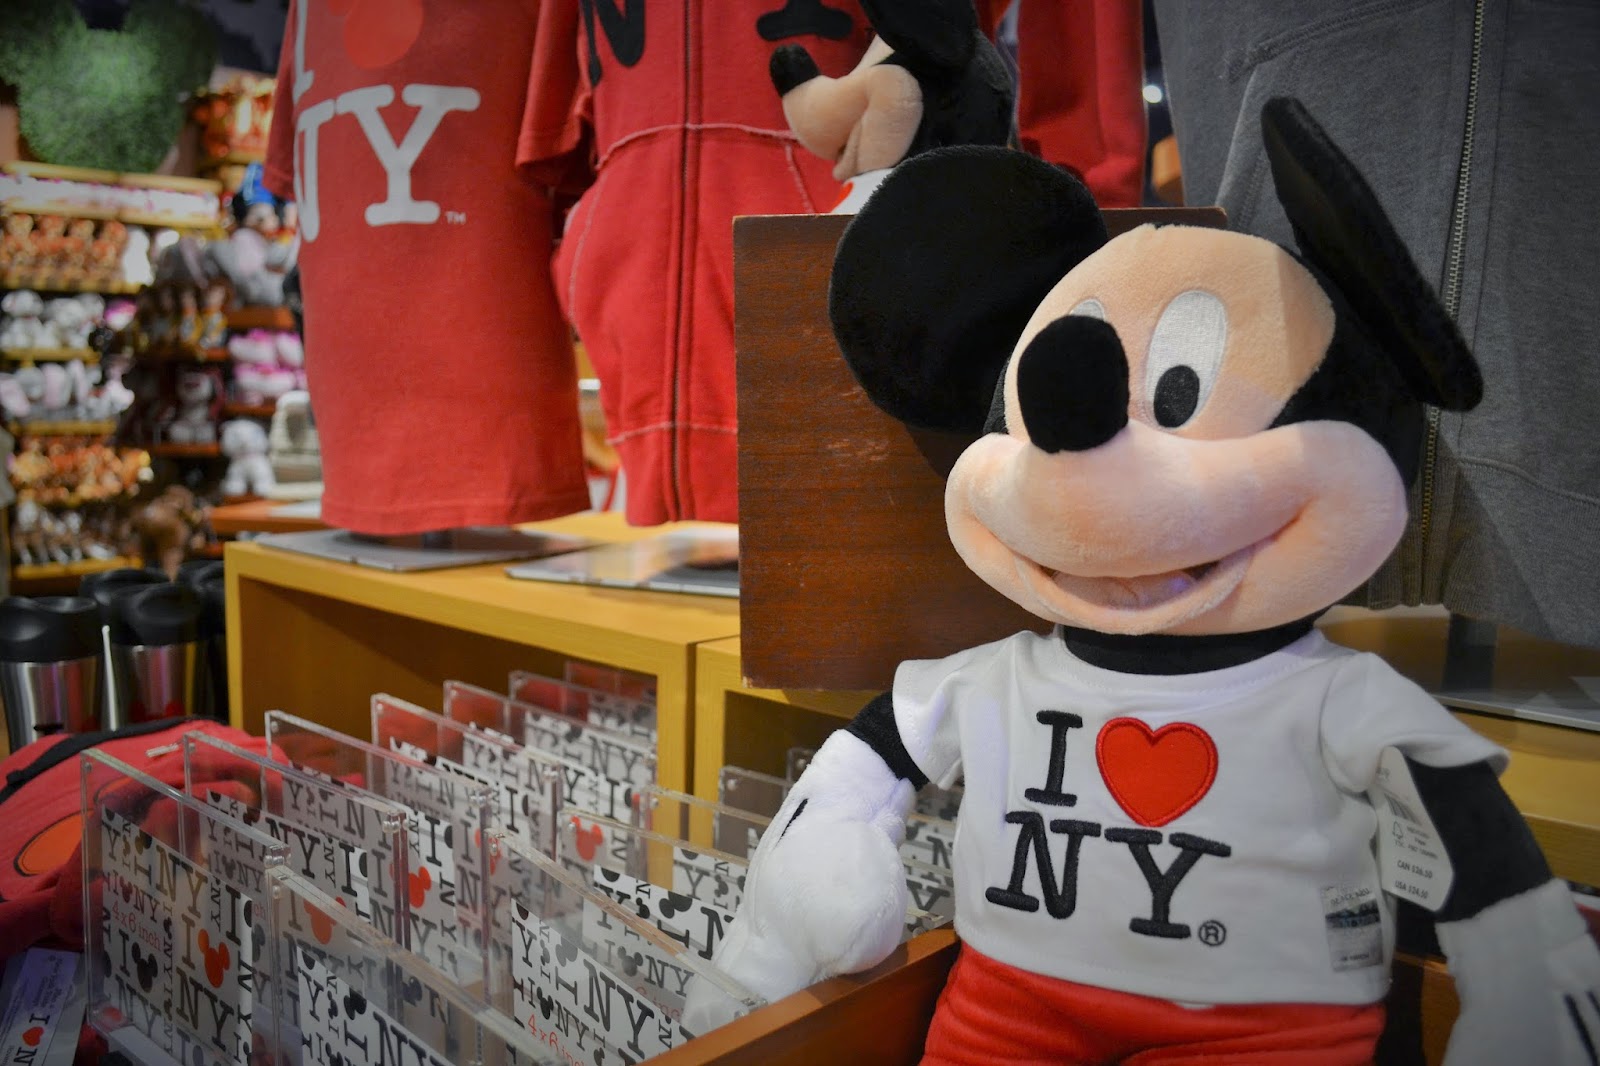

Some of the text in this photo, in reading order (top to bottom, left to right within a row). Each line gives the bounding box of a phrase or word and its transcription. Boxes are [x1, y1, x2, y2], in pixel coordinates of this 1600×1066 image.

[1023, 709, 1083, 807] I
[424, 812, 443, 867] I
[1396, 859, 1411, 873] CAN
[155, 845, 209, 919] NY
[338, 842, 358, 898] I
[985, 810, 1232, 939] NY
[1394, 880, 1407, 892] USA
[132, 884, 161, 924] NY
[643, 954, 695, 998] NY
[176, 966, 234, 1052] NY
[555, 1000, 590, 1051] NY
[584, 958, 655, 1061] NY
